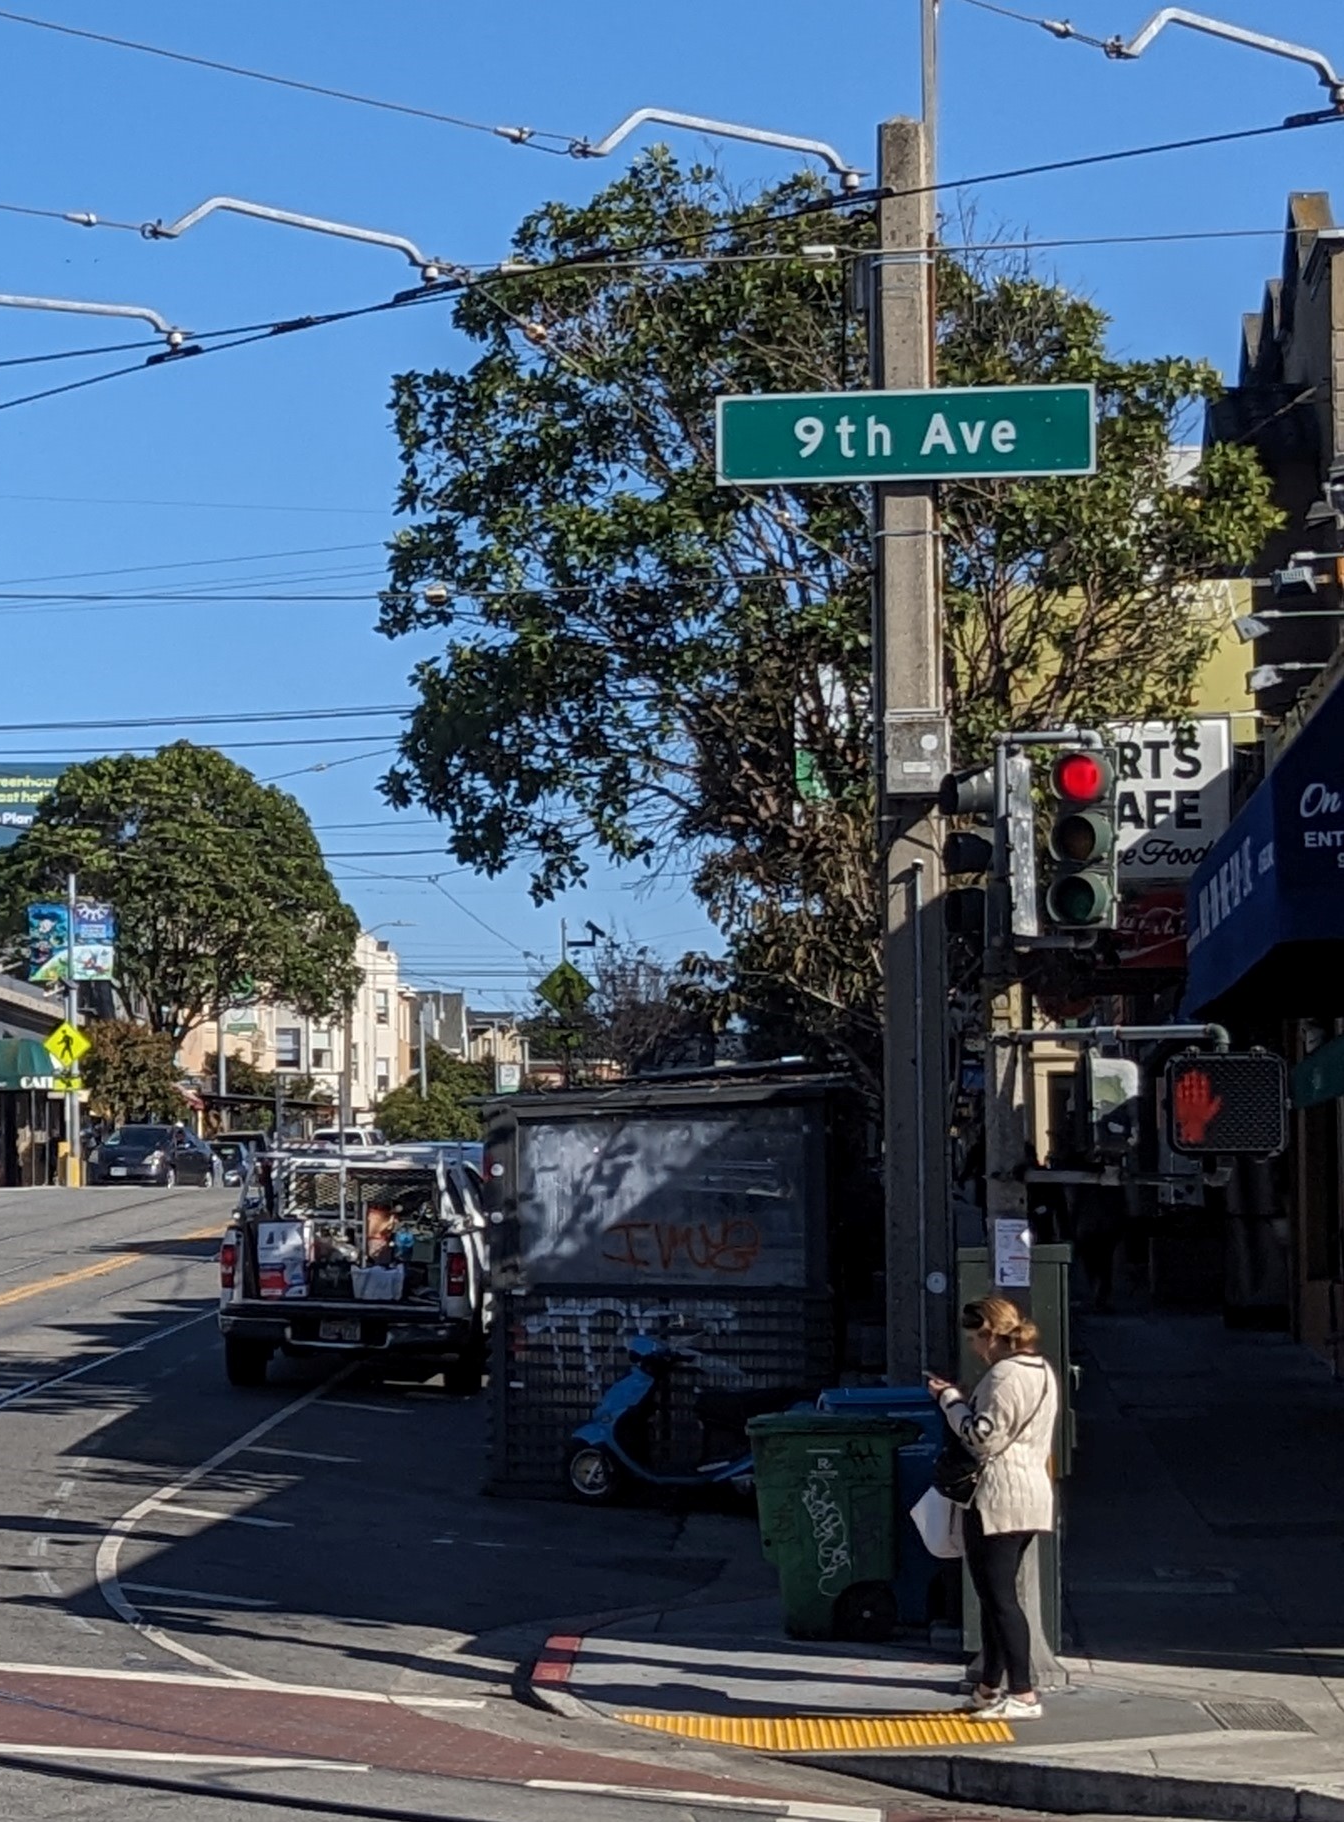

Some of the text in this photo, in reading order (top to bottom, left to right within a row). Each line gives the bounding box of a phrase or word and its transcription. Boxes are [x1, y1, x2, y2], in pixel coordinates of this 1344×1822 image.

[794, 413, 1018, 458] 9th Ave
[21, 791, 51, 804] hal
[1116, 790, 1202, 830] AFE
